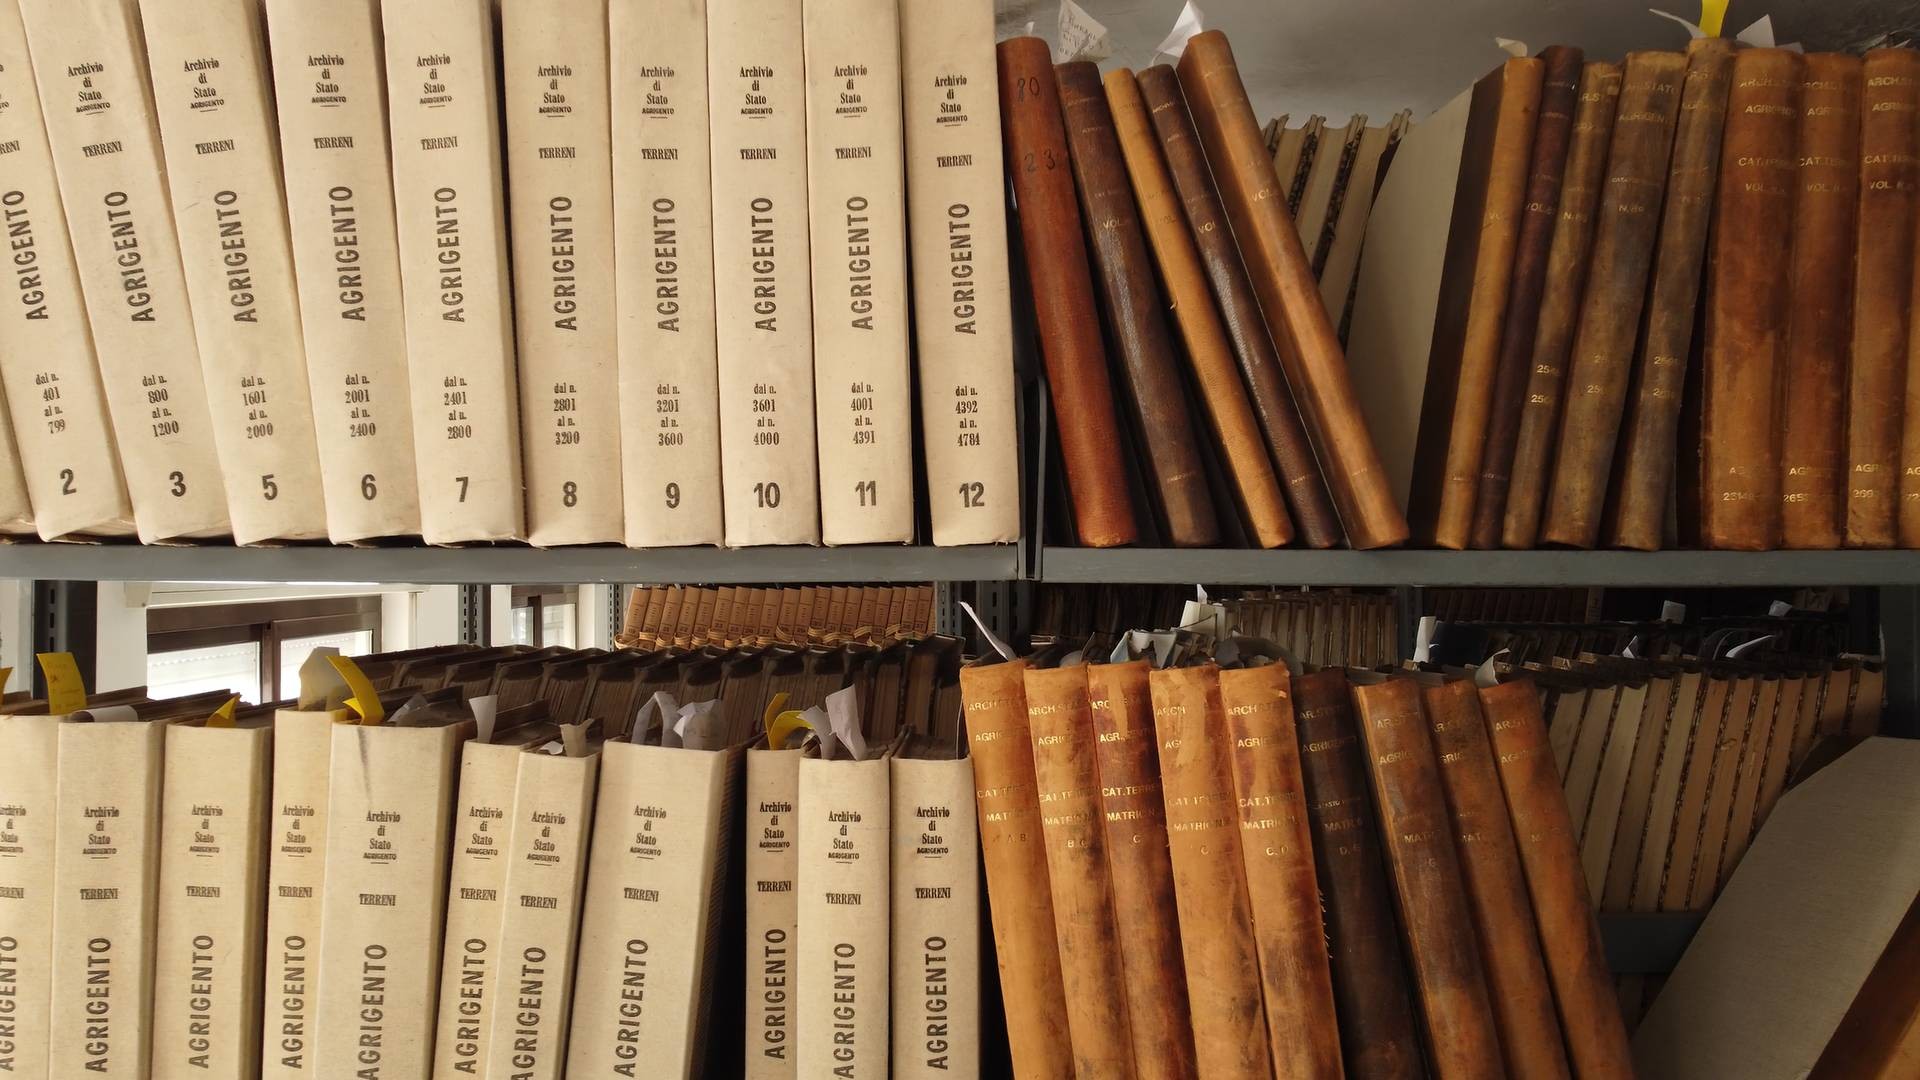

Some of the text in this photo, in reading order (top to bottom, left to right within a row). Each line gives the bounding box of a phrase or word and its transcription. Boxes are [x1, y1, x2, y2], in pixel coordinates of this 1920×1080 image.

[184, 58, 219, 72] Archivio
[308, 54, 344, 66] Archivio
[417, 54, 450, 67] Archivio
[68, 62, 103, 77] Archivio
[322, 68, 331, 79] di
[429, 68, 438, 80] di
[538, 65, 572, 77] Archivio
[641, 66, 674, 77] Archivio
[740, 66, 773, 78] Archivio
[834, 64, 867, 77] Archivio
[83, 77, 92, 88] di
[198, 72, 208, 84] di
[550, 79, 558, 90] di
[846, 79, 854, 90] di
[935, 75, 967, 87] Archivio
[316, 82, 339, 93] Stato
[424, 82, 445, 94] Stato
[653, 80, 661, 91] di
[752, 80, 759, 91] di
[78, 91, 102, 102] Stato
[193, 87, 216, 99] Stato
[544, 92, 565, 103] Stato
[646, 93, 668, 105] Stato
[746, 93, 766, 105] Stato
[840, 92, 861, 105] Stato
[947, 89, 954, 100] di
[941, 102, 961, 113] Stato
[82, 141, 123, 157] TERRENI
[195, 139, 235, 155] TERRENI
[314, 136, 354, 149] TERRENI
[420, 136, 458, 150] TERRENI
[539, 147, 575, 159] TERRENI
[641, 148, 678, 160] TERRENI
[740, 148, 776, 160] TERRENI
[835, 146, 871, 159] TERRENI
[937, 154, 972, 167] TERRENI
[2, 191, 48, 320] AGRIGENTO
[104, 192, 156, 321] AGRIGENTO
[214, 190, 258, 323] AGRIGENTO
[328, 186, 365, 321] AGRIGENTO
[434, 188, 465, 322] AGRIGENTO
[550, 197, 577, 331] AGRIGENTO
[652, 198, 679, 332] AGRIGENTO
[751, 198, 776, 332] AGRIGENTO
[846, 196, 873, 330] AGRIGENTO
[948, 204, 976, 334] AGRIGENTO
[346, 373, 370, 385] dal n.
[43, 387, 60, 401] 401
[554, 382, 576, 394] dal n.
[956, 386, 967, 396] dal
[148, 388, 168, 404] 800
[243, 390, 266, 406] 1601
[345, 389, 370, 403] 2001
[444, 392, 467, 406] 2401
[554, 398, 576, 411] 2801
[657, 399, 679, 413] 3201
[753, 399, 775, 412] 3601
[851, 398, 873, 411] 4001
[956, 400, 978, 414] 4392
[351, 407, 370, 418] al n.
[48, 419, 65, 434] 799
[557, 416, 575, 426] al n.
[960, 418, 977, 428] al n.
[152, 420, 179, 437] 1200
[246, 423, 273, 439] 2000
[350, 423, 376, 437] 2400
[447, 425, 471, 439] 2800
[556, 431, 580, 445] 3200
[658, 432, 683, 446] 3600
[753, 432, 779, 445] 4000
[853, 430, 875, 444] 4391
[957, 433, 980, 447] 4784
[60, 469, 77, 495] 2
[169, 471, 187, 497] 3
[262, 474, 278, 500] 5
[361, 474, 377, 501] 6
[456, 476, 468, 502] 7
[563, 481, 577, 507] 8
[666, 482, 680, 509] 9
[754, 482, 780, 508] 10
[855, 481, 876, 506] 11
[959, 482, 985, 508] 12
[469, 806, 503, 819] Archivio
[634, 805, 666, 819] Archivio
[760, 801, 792, 812] Archivio
[916, 807, 950, 818] Archivio
[366, 810, 400, 823] Archivio
[531, 811, 566, 824] Archivio
[771, 815, 778, 826] di
[828, 810, 861, 822] Archivio
[377, 825, 385, 836] di
[480, 821, 488, 831] di
[542, 826, 550, 837] di
[644, 820, 652, 831] di
[840, 825, 847, 836] di
[929, 820, 936, 831] di
[472, 833, 493, 845] Stato
[636, 833, 656, 846] Stato
[764, 828, 784, 839] Stato
[922, 833, 942, 844] Stato
[369, 838, 391, 850] Stato
[533, 839, 555, 852] Stato
[833, 838, 853, 850] Stato
[186, 886, 220, 897] TERRENI
[278, 886, 312, 898] TERRENI
[757, 880, 791, 892] TERRENI
[80, 888, 118, 900] TERRENI
[461, 888, 496, 901] TERRENI
[624, 887, 659, 902] TERRENI
[826, 892, 861, 905] TERRENI
[915, 887, 951, 899] TERRENI
[359, 894, 396, 906] TERRENI
[520, 895, 557, 909] TERRENI
[765, 929, 786, 1059] AGRIGENTO
[85, 938, 111, 1073] AGRIGENTO
[188, 935, 214, 1069] AGRIGENTO
[281, 936, 306, 1069] AGRIGENTO
[454, 939, 487, 1074] AGRIGENTO
[614, 939, 648, 1078] AGRIGENTO
[925, 936, 948, 1070] AGRIGENTO
[357, 945, 387, 1080] AGRIGENTO
[833, 943, 855, 1080] AGRIGENTO
